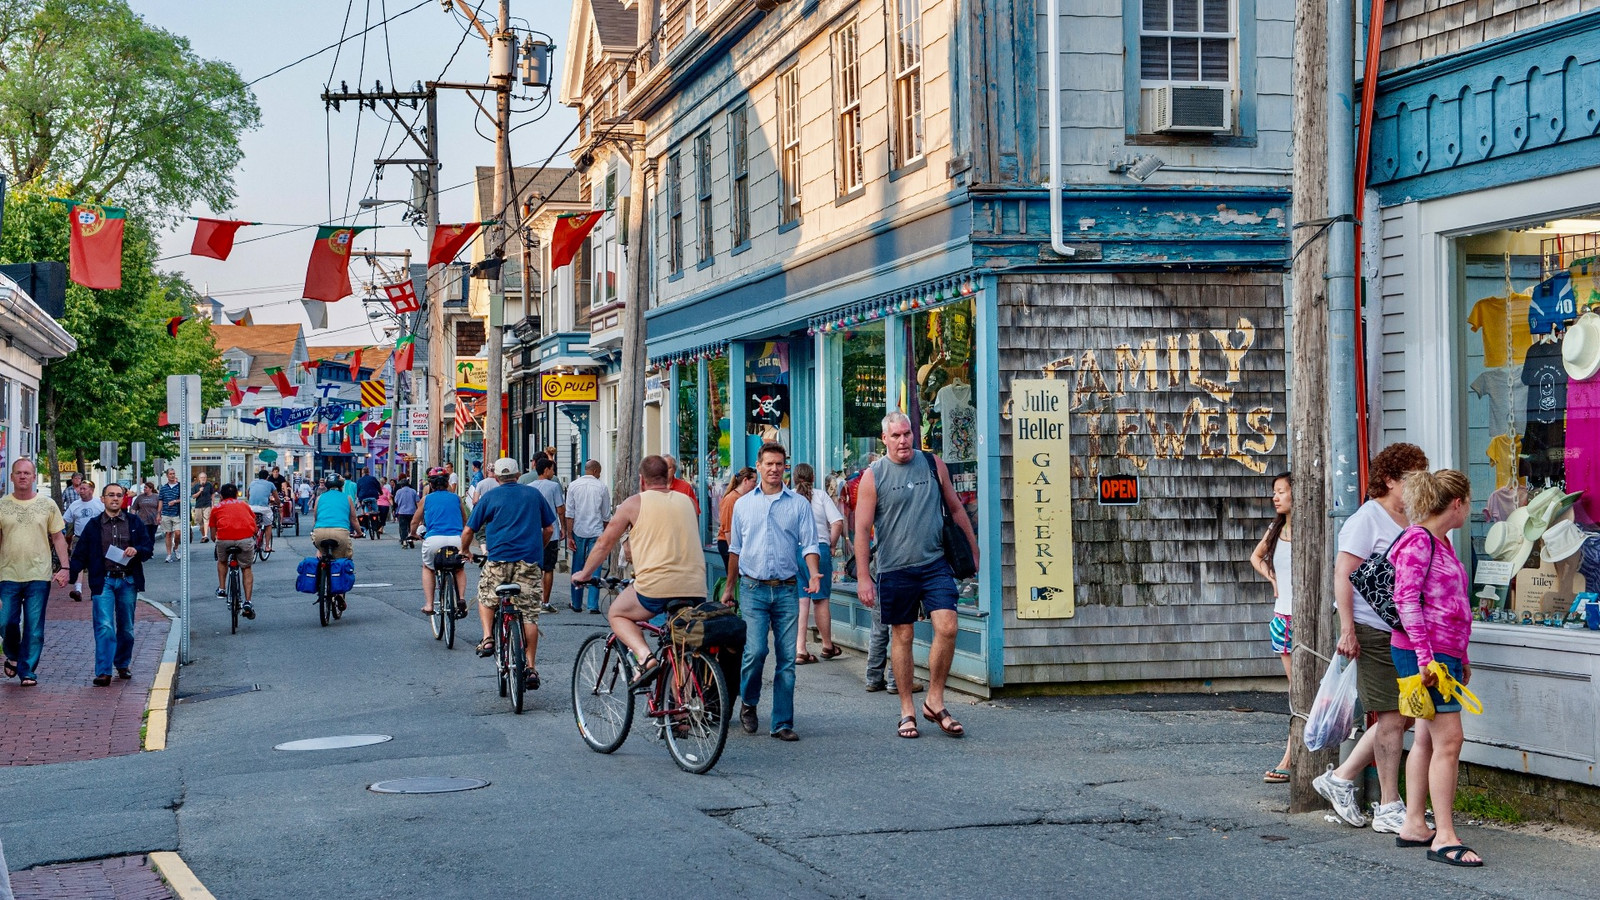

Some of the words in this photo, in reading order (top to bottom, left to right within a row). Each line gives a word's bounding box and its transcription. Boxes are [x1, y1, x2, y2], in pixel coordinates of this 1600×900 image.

[1560, 298, 1573, 315] 10
[564, 381, 595, 392] PULP
[1021, 389, 1059, 412] Julie
[1018, 417, 1065, 440] Heller
[1101, 479, 1137, 499] OPEN
[1032, 452, 1053, 577] GALLERY
[1532, 576, 1554, 589] Tilley
